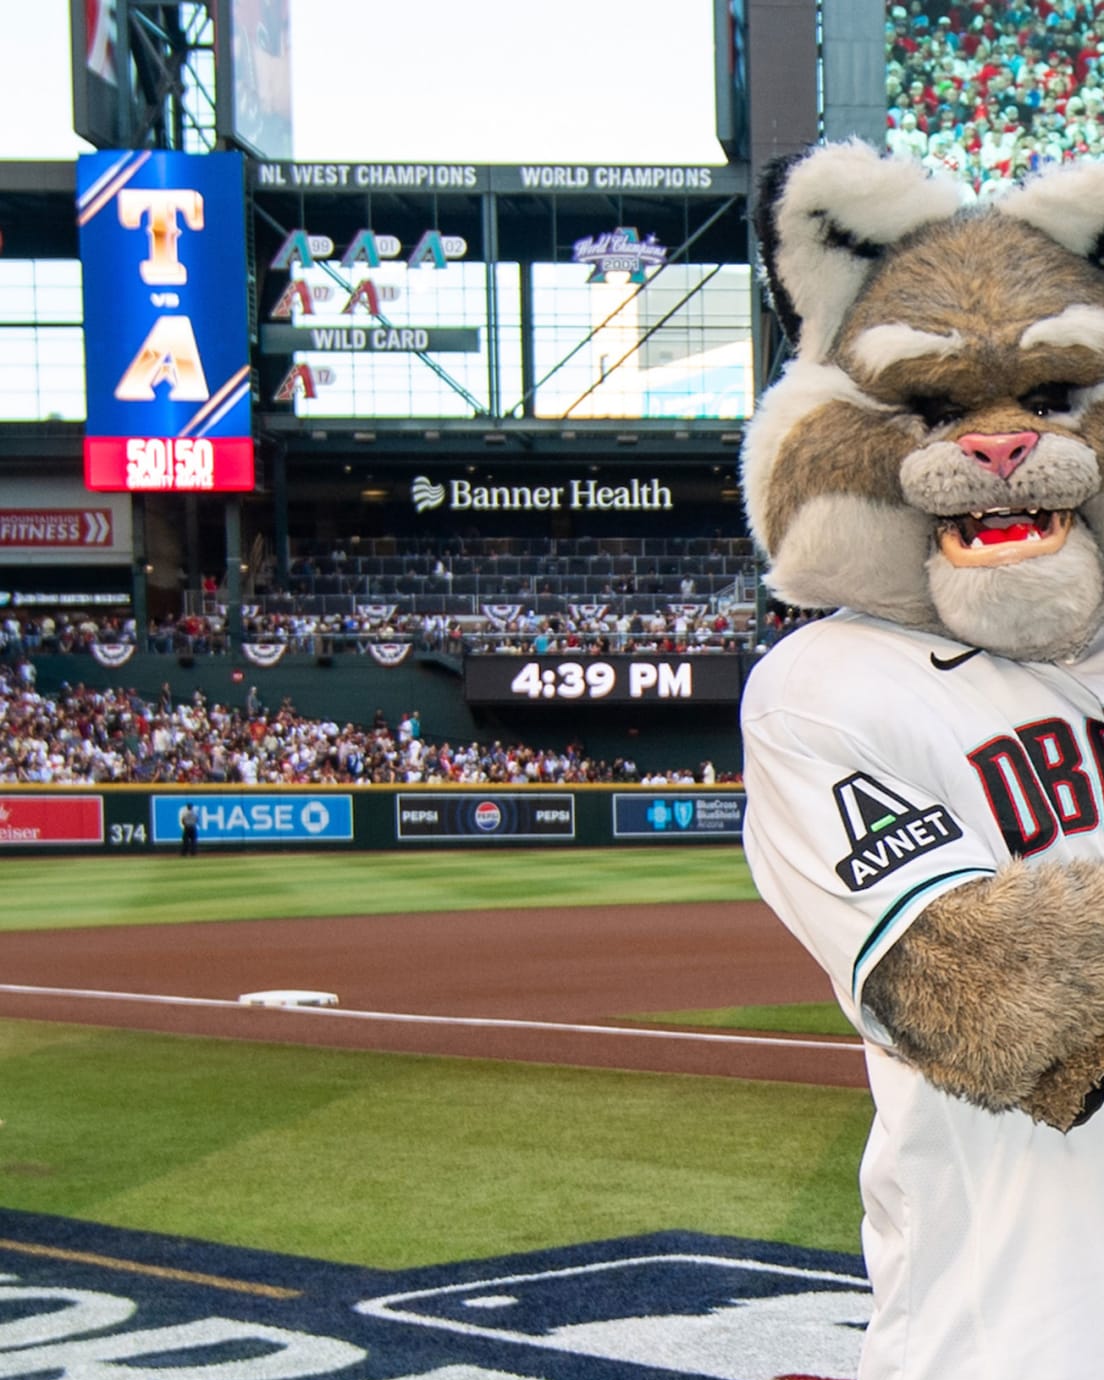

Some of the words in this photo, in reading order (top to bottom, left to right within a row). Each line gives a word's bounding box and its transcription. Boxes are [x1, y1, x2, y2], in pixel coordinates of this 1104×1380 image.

[260, 164, 286, 184] NL
[293, 165, 350, 186] WEST
[356, 165, 477, 187] CHAMPIONS
[521, 167, 589, 188] WORLD
[594, 167, 712, 188] CHAMPIONS
[117, 188, 204, 286] T
[313, 329, 366, 350] WILD
[373, 329, 429, 350] CARD
[113, 315, 211, 401] A
[450, 480, 564, 510] Banner
[570, 479, 673, 510] Health
[1, 524, 80, 541] FITNESS
[511, 661, 616, 698] 4:39
[629, 662, 692, 698] PM
[402, 810, 439, 822] PEPSI
[536, 810, 570, 823] PEPSI
[111, 824, 147, 843] 374
[850, 810, 950, 886] AVNET
